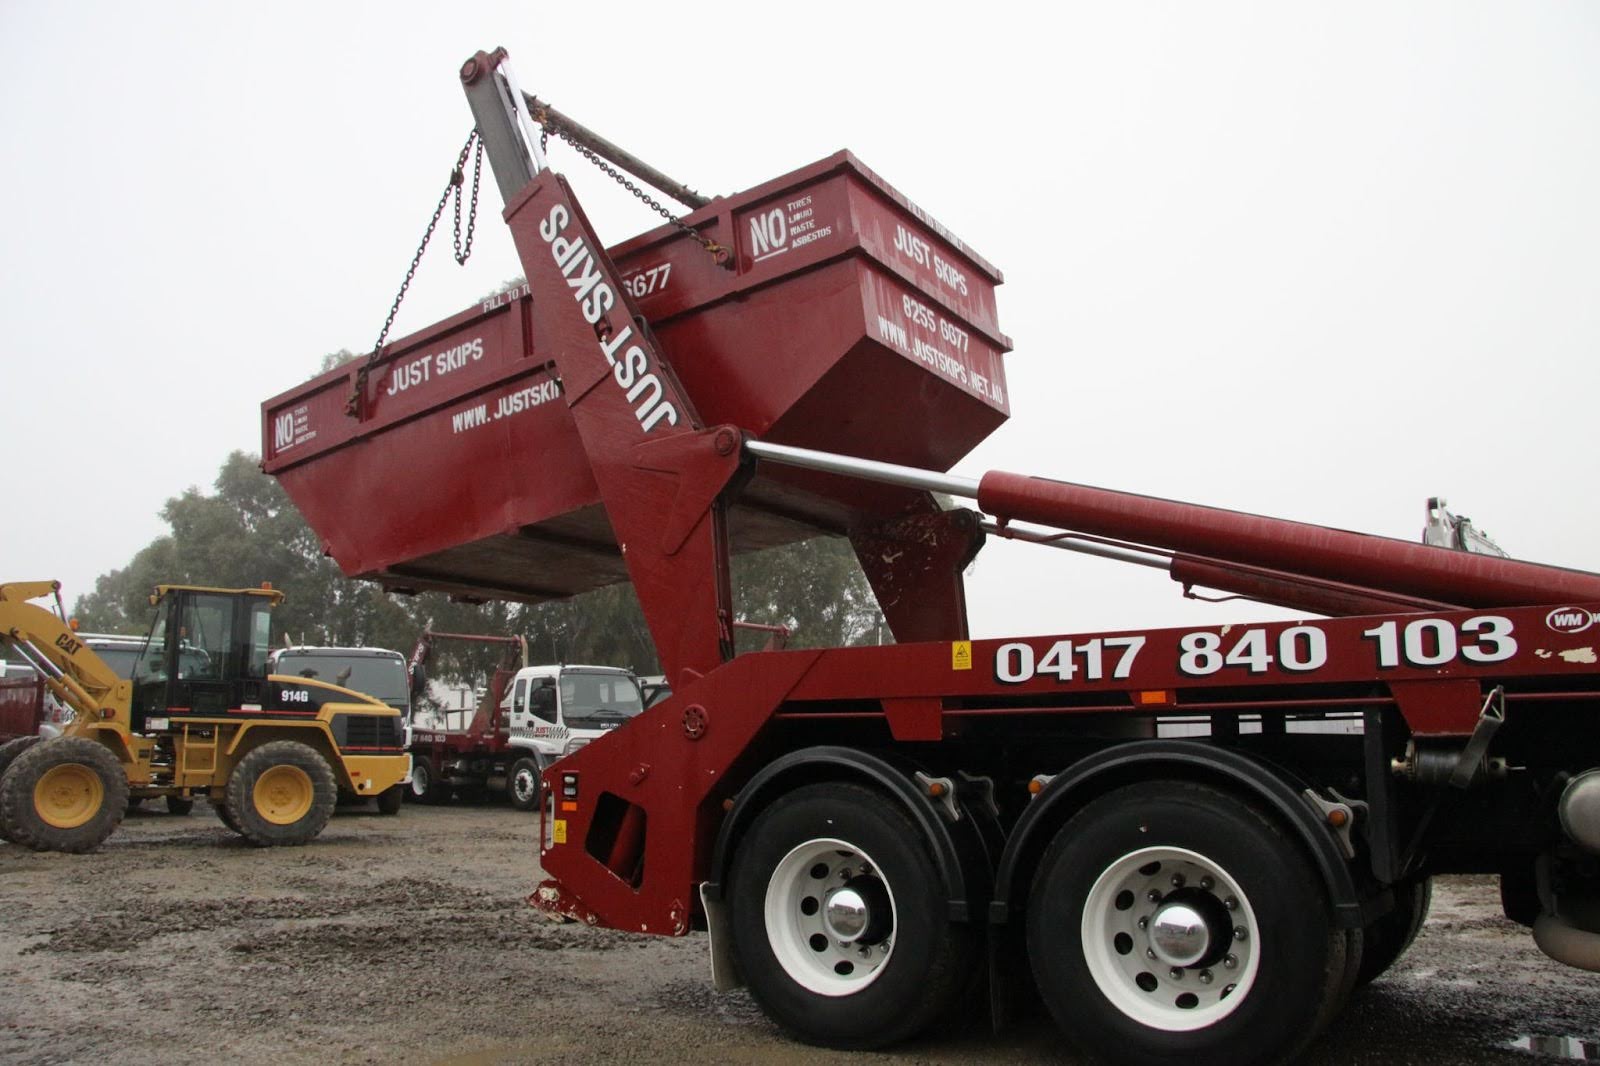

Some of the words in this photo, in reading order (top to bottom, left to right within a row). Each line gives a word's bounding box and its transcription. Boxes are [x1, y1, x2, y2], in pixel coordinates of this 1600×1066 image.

[787, 196, 812, 212] TYRES
[788, 209, 813, 224] LIQUID
[750, 207, 786, 256] NO
[790, 219, 815, 236] WASTE
[791, 226, 832, 250] ASBESTOS
[539, 203, 615, 325] SKIPS
[893, 225, 931, 270] JUST
[934, 254, 968, 296] SKIPS
[483, 295, 505, 314] FILL
[507, 287, 519, 302] TO
[902, 294, 936, 333] 8255
[387, 355, 433, 397] JUST
[436, 337, 484, 376] SKIPS
[600, 325, 678, 433] JUST
[275, 413, 294, 449] NO
[1554, 613, 1583, 627] WM
[55, 633, 83, 656] CAT
[995, 635, 1147, 685] 0417
[1179, 625, 1328, 677] 840
[1363, 616, 1518, 669] 103
[281, 690, 309, 703] 914G
